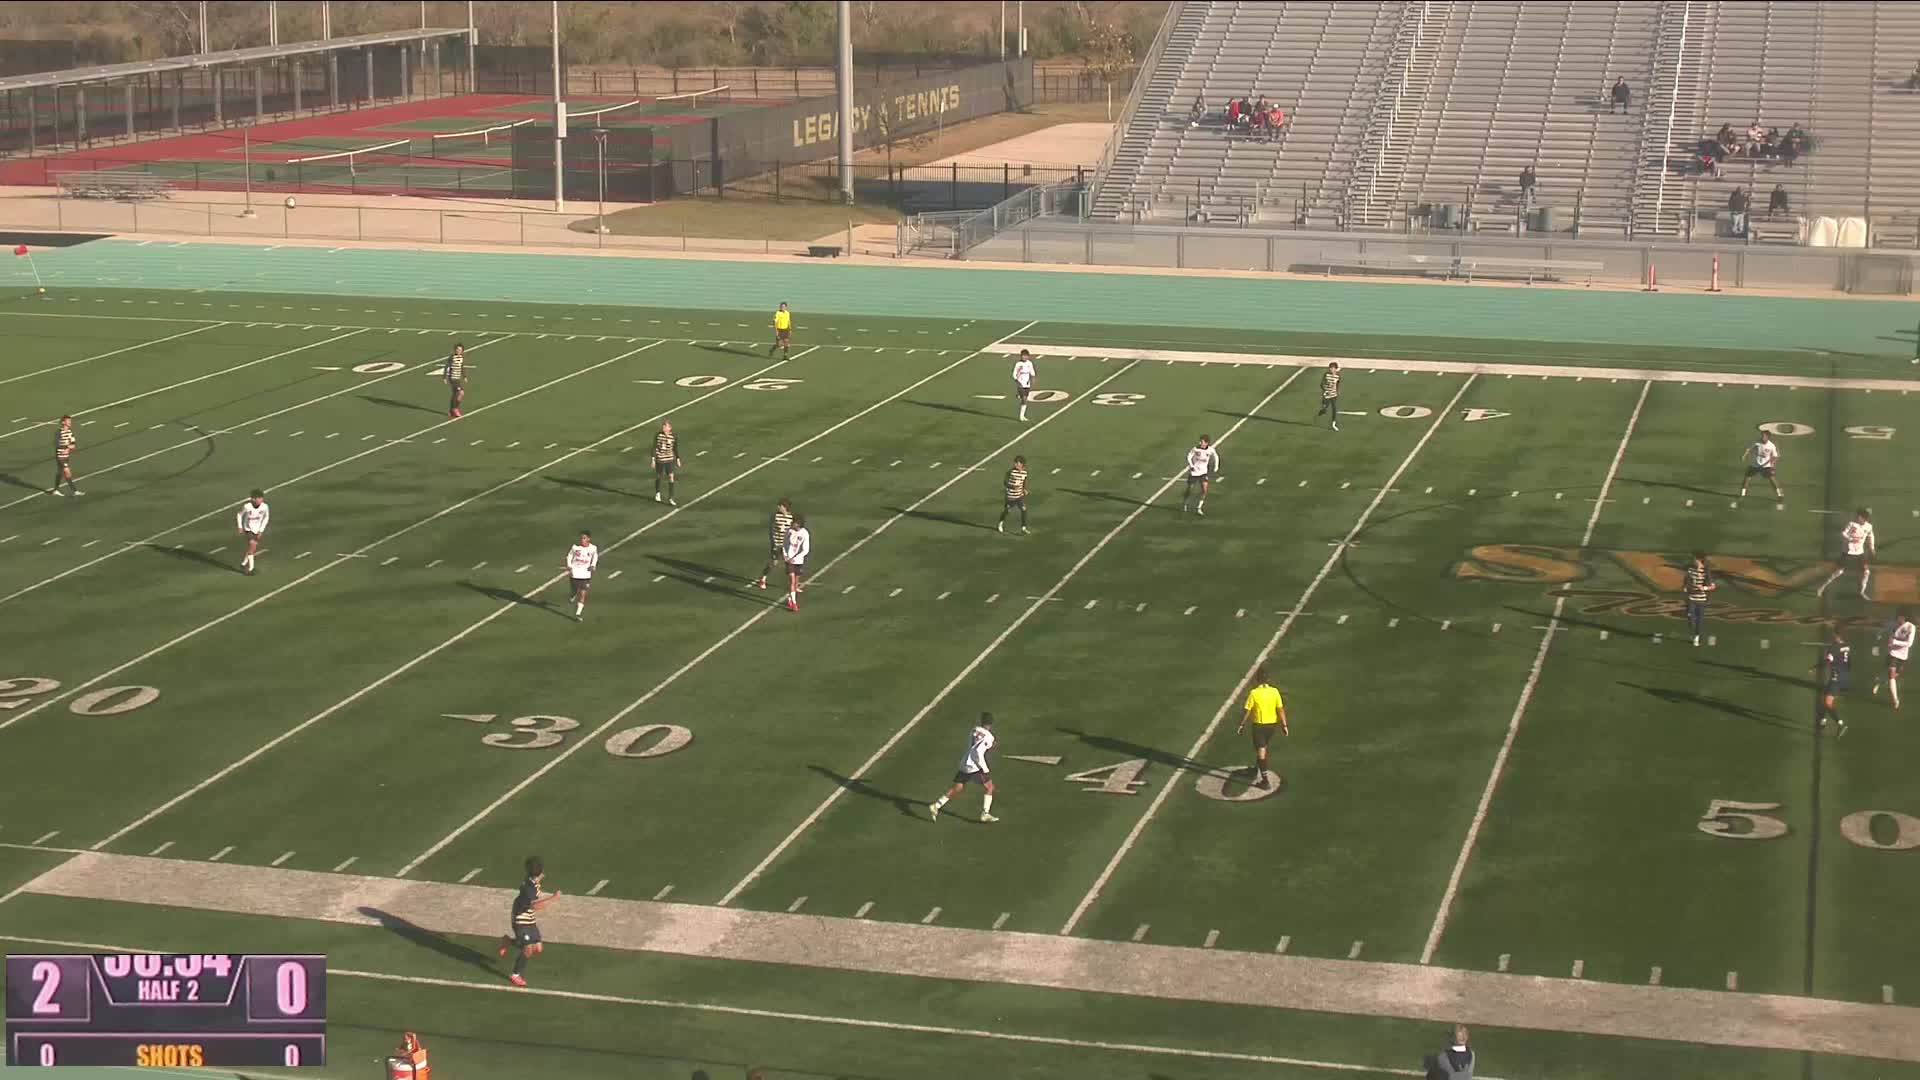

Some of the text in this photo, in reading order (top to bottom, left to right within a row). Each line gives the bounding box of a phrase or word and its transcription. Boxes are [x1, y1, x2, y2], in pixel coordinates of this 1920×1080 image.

[895, 85, 960, 121] TENNIS
[481, 715, 693, 757] 30
[1064, 758, 1281, 800] 40
[1697, 799, 1920, 849] 50
